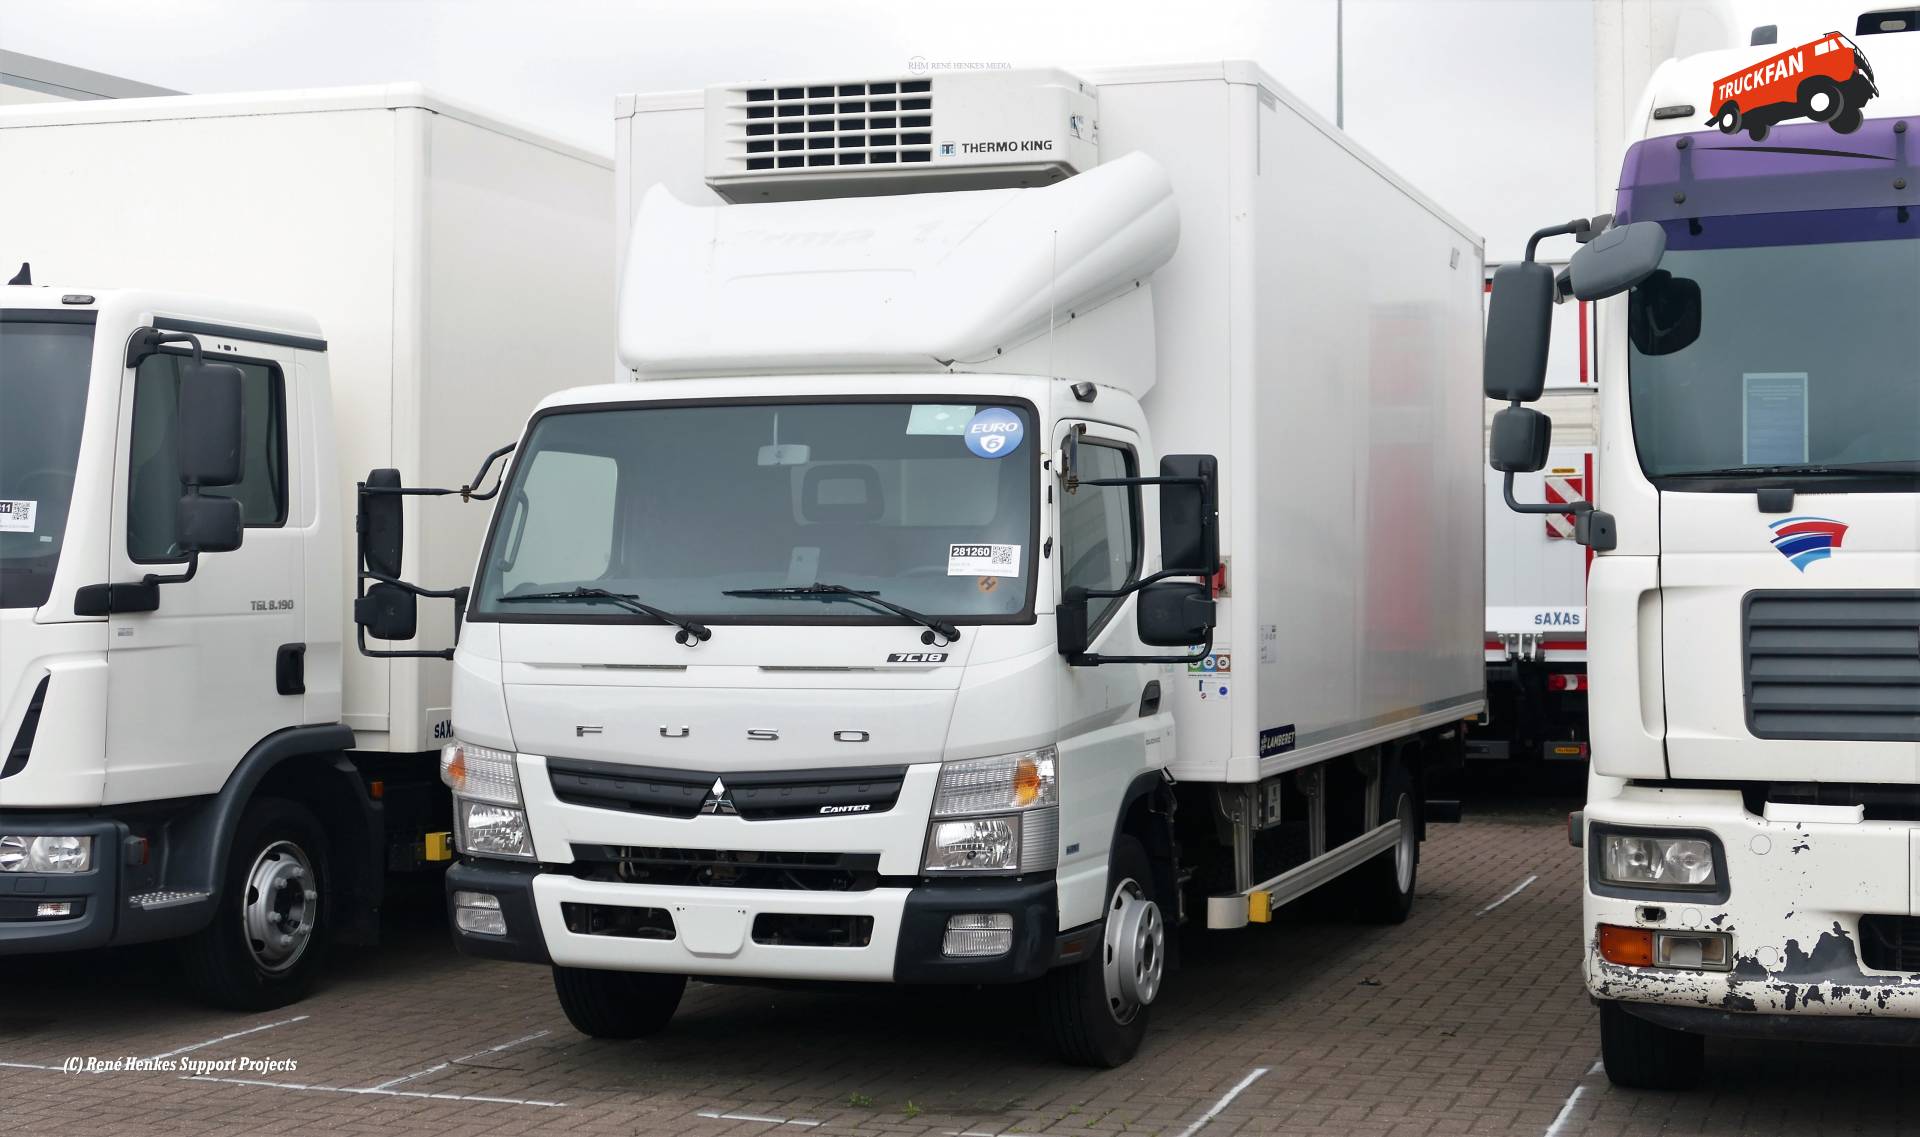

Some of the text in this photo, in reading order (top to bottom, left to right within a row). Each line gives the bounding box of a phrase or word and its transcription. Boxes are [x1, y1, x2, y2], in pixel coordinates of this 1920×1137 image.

[962, 140, 1053, 154] THERMO KING
[971, 422, 1018, 434] EURO
[986, 438, 1001, 449] 6
[952, 547, 990, 557] 281260
[250, 599, 294, 611] TGL 8.190
[895, 652, 943, 662] 7C18
[576, 724, 870, 743] FUSO
[1267, 731, 1296, 749] LAMBERET
[820, 804, 870, 814] CANTER
